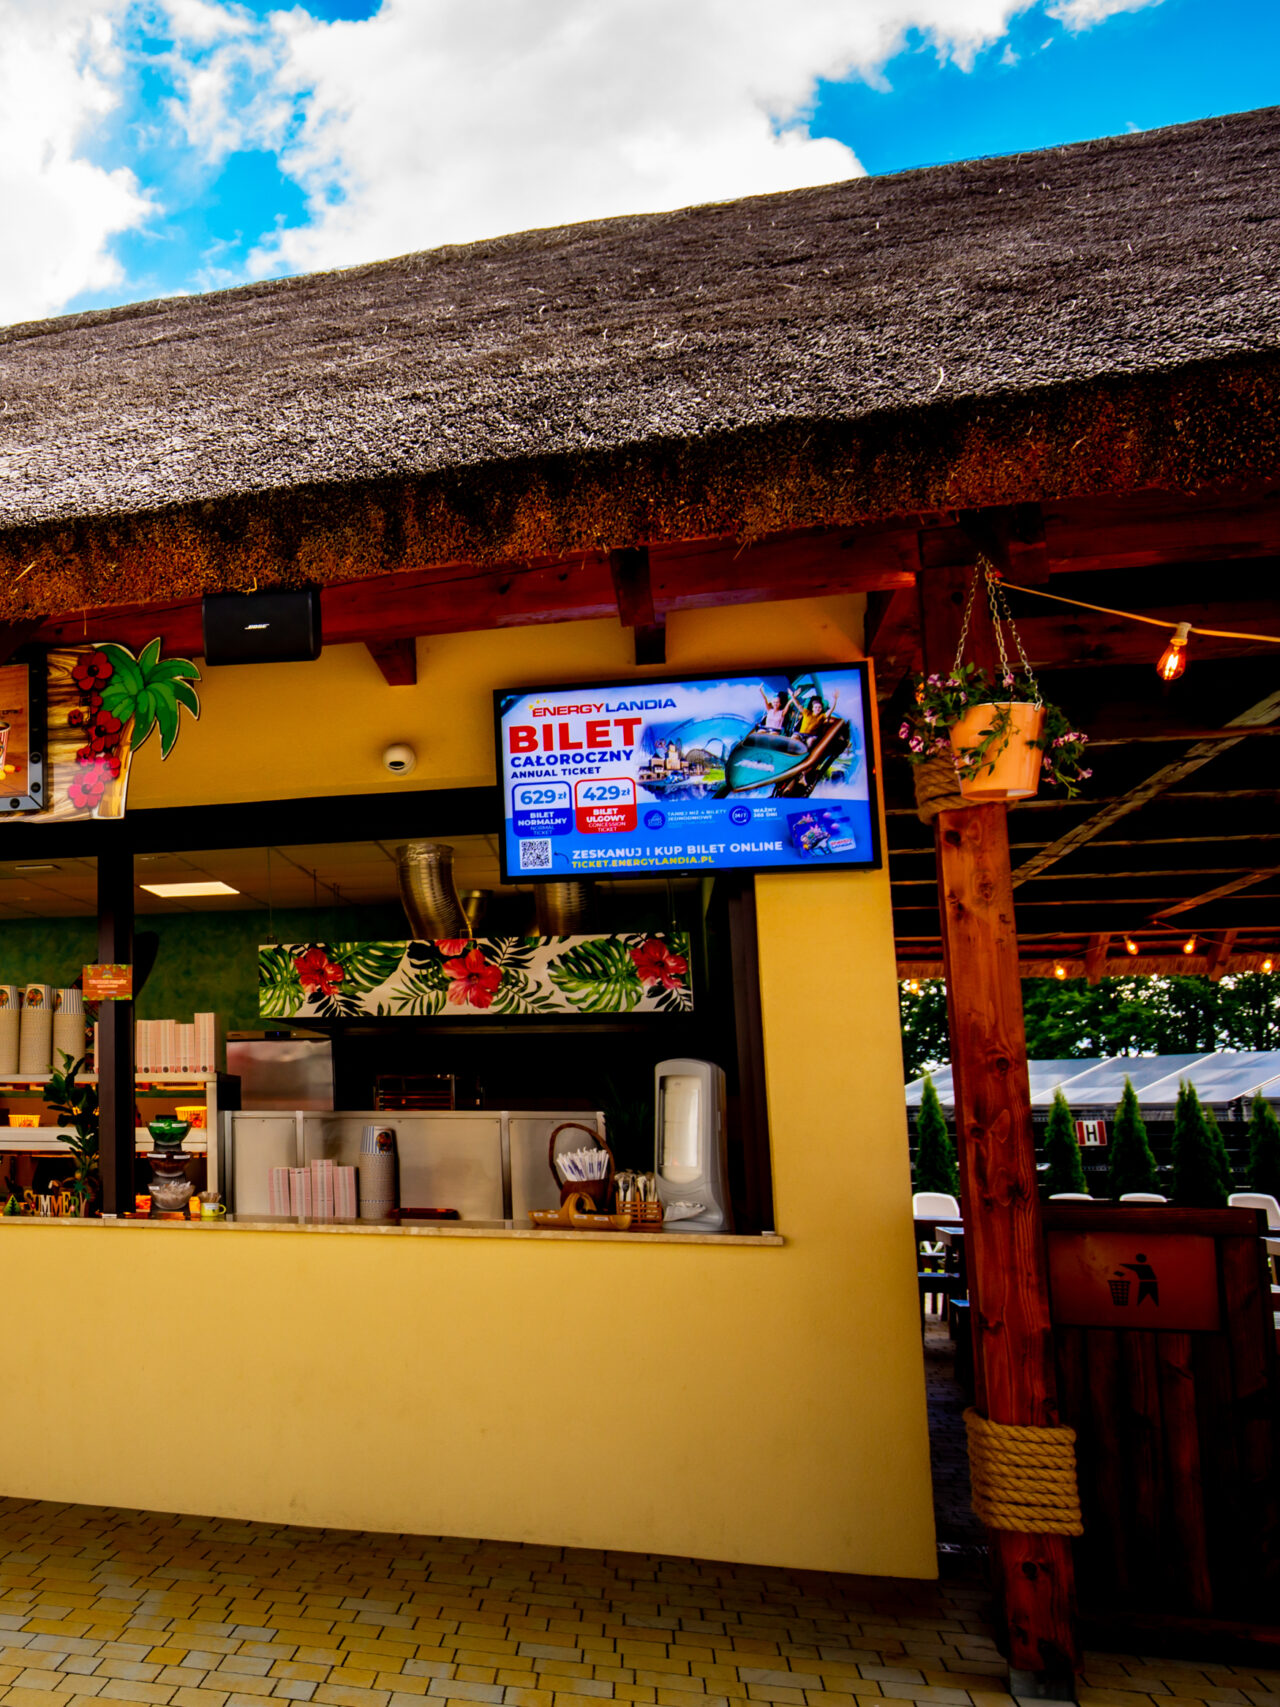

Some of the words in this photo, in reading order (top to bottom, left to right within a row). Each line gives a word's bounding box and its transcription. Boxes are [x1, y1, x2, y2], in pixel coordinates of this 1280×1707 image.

[532, 698, 677, 717] ENERGYLANDIA
[509, 717, 642, 754] BILET
[510, 749, 634, 768] CAŁOROCZNY
[511, 769, 558, 779] ANNUAL
[561, 766, 602, 776] TICKET
[520, 789, 556, 805] 629
[583, 786, 620, 801] 429
[518, 818, 567, 826] NORMALNY
[530, 811, 555, 819] BILET
[586, 815, 626, 823] ULGOWY
[572, 847, 642, 859] ZESKANUJ
[655, 845, 682, 856] KUP
[687, 844, 725, 854] BILET
[730, 841, 783, 853] ONLINE
[571, 856, 715, 869] TICKET.ENERGYLANDIA.PL
[1085, 1124, 1097, 1142] H
